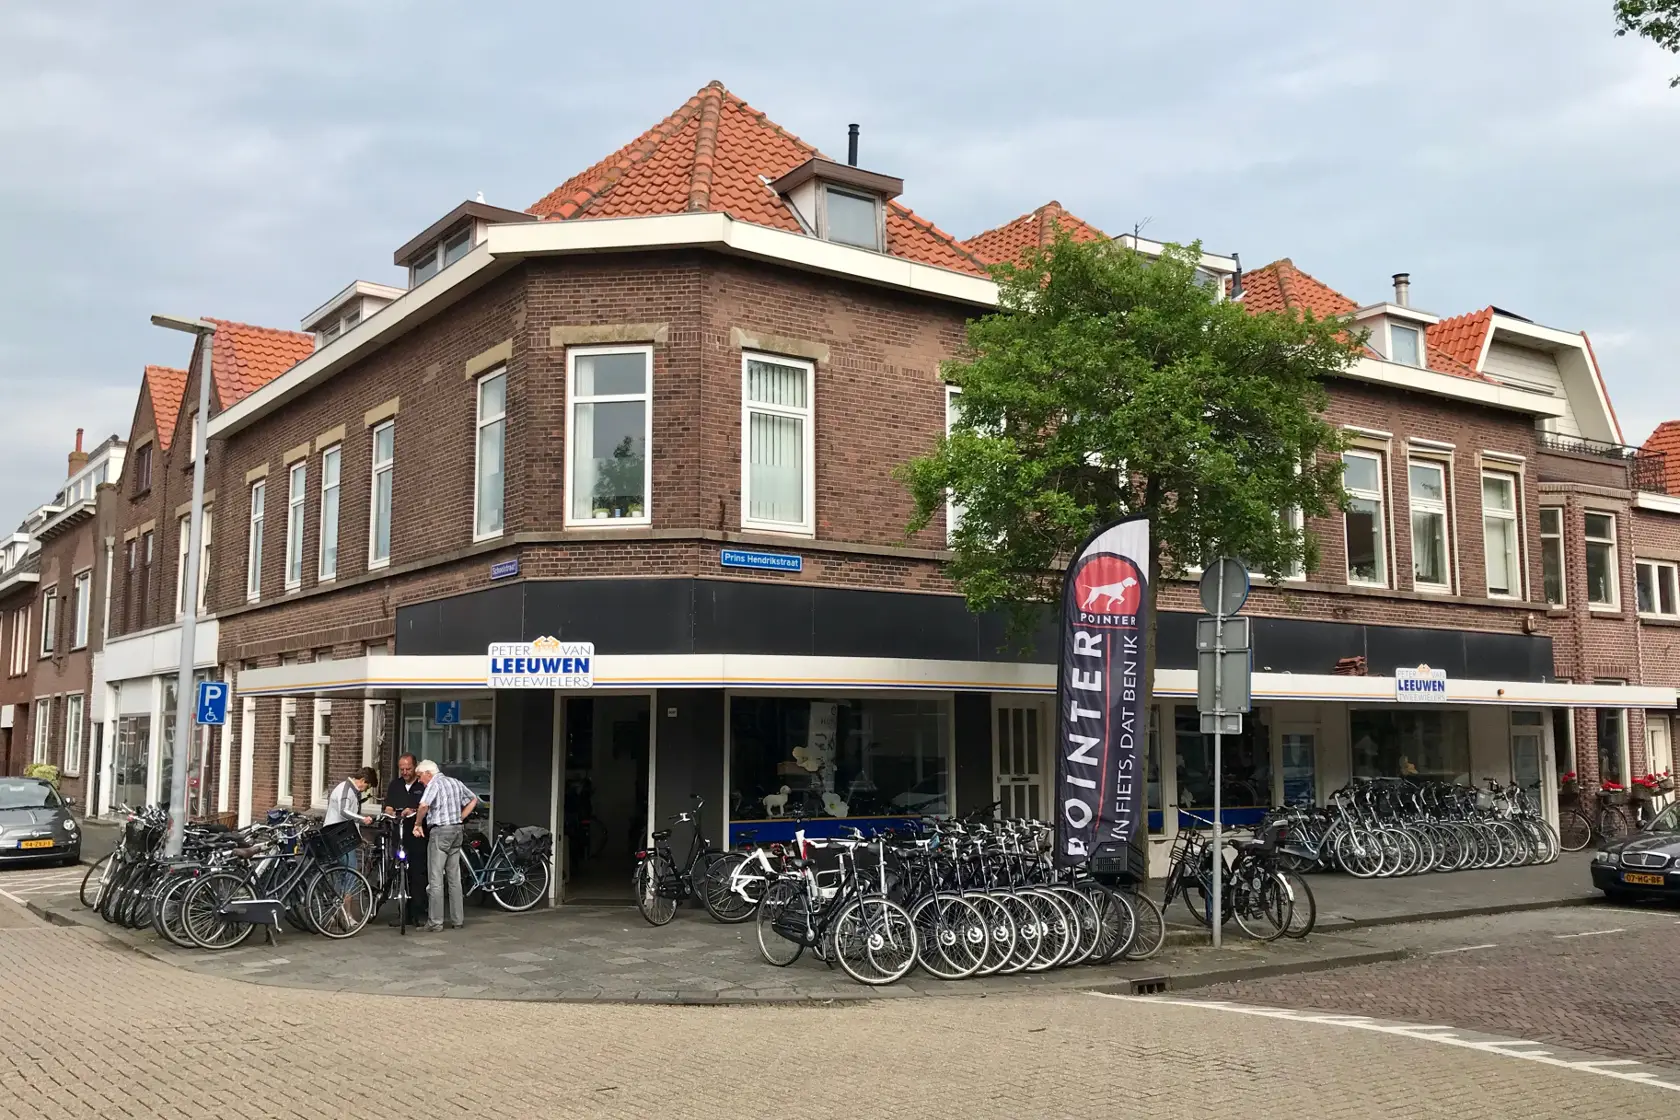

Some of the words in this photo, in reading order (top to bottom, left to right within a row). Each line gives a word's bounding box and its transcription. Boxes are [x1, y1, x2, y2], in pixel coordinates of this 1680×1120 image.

[724, 553, 745, 562] Prins
[747, 554, 799, 567] Hendrikstraat
[1080, 613, 1136, 626] POINTER
[491, 645, 531, 656] PETER
[561, 645, 591, 656] VAN
[1123, 635, 1138, 654] IK
[491, 657, 590, 674] LEEUWEN
[491, 676, 590, 687] TWEEWIELERS
[1123, 661, 1137, 701] BEN
[1398, 679, 1445, 692] LEEUWEN
[204, 685, 222, 707] P
[1120, 707, 1135, 749] DAT
[1065, 630, 1103, 857] POINTER
[1115, 754, 1136, 813] FIETS,
